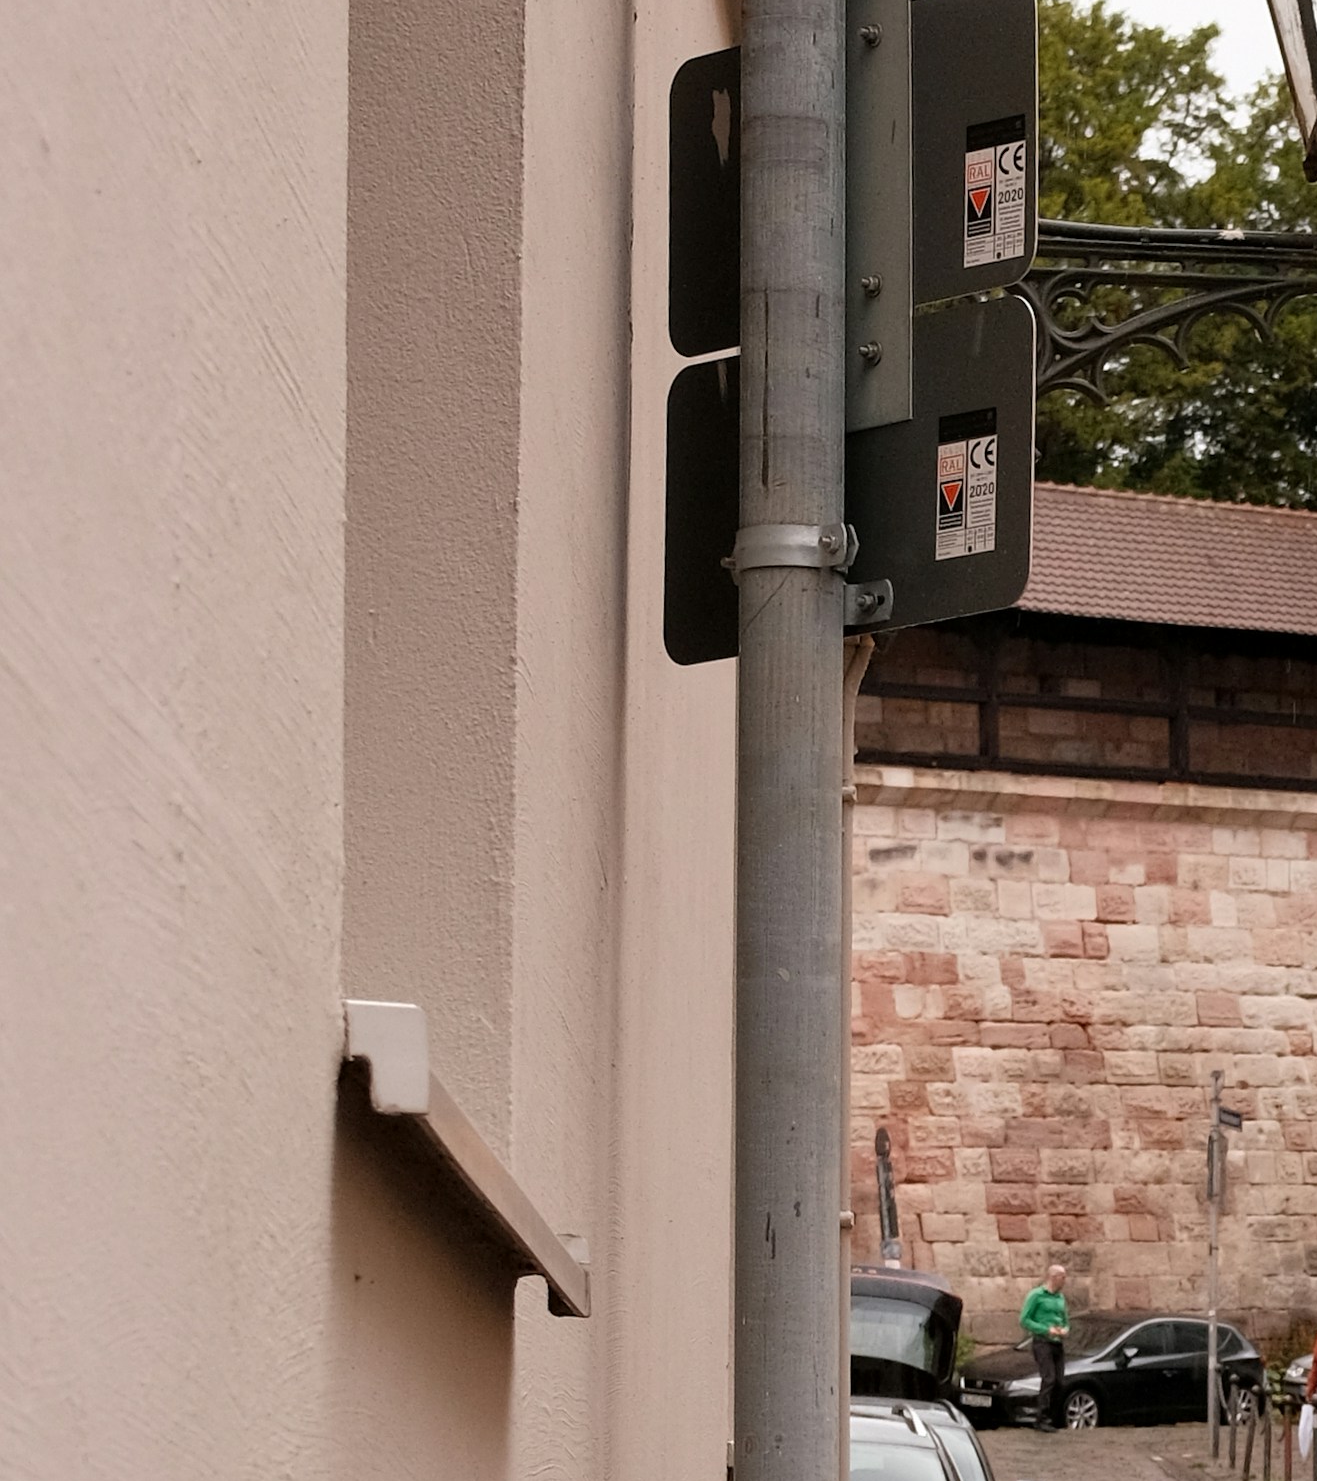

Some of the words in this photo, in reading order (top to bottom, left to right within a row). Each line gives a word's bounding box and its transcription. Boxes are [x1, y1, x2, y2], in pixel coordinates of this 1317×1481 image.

[969, 164, 991, 181] RAL
[998, 187, 1024, 205] 2020
[941, 458, 963, 474] RAL
[969, 481, 995, 499] 2020
